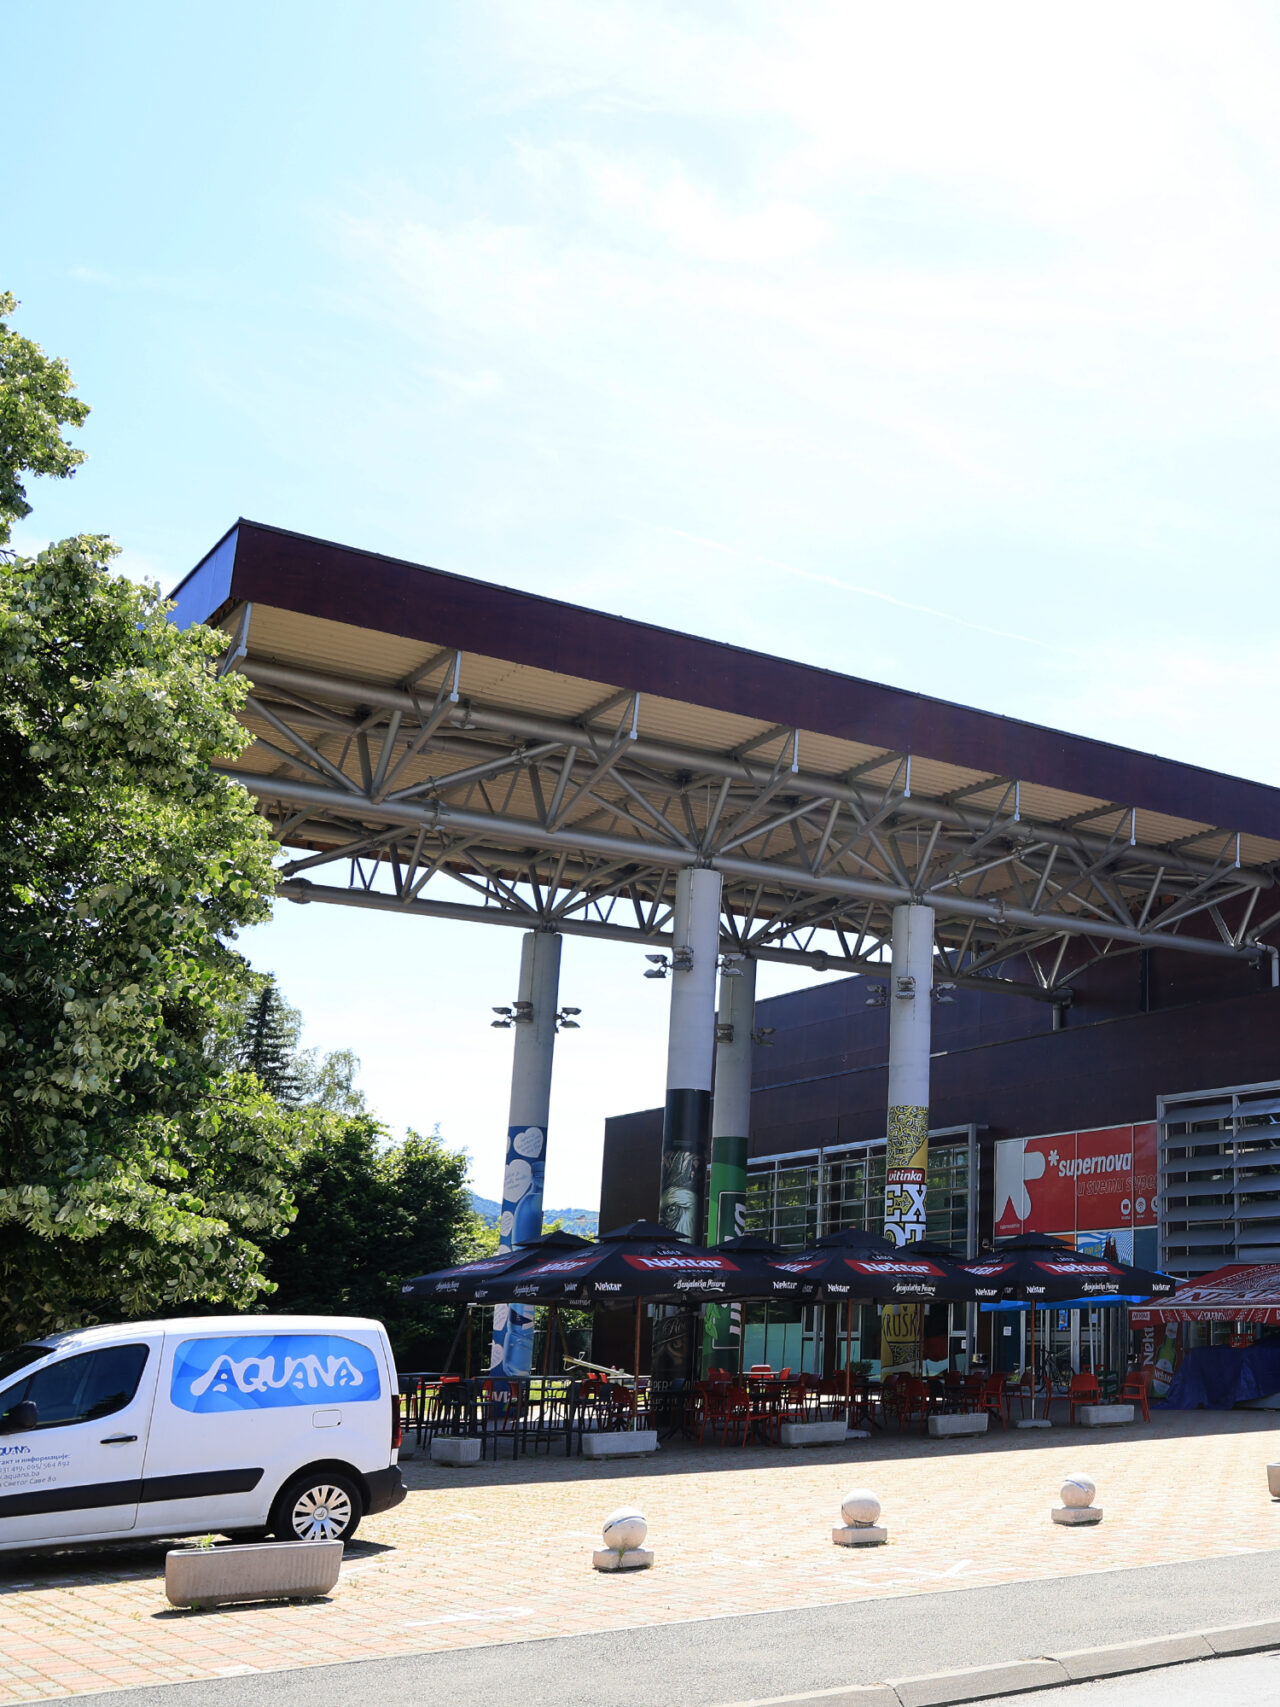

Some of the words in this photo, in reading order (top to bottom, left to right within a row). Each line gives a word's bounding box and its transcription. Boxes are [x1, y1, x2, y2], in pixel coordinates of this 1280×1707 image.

[1058, 1152, 1132, 1180] supernova
[888, 1170, 923, 1181] vitinka
[1077, 1182, 1087, 1197] u
[1088, 1178, 1125, 1195] svemu
[1125, 1174, 1158, 1194] supe
[885, 1184, 927, 1222] EX
[636, 1258, 724, 1268] Nektar
[857, 1262, 932, 1274] Nektar
[1046, 1263, 1112, 1274] Nektar
[594, 1282, 622, 1291] Nektar
[773, 1281, 797, 1290] Nektar
[827, 1283, 850, 1293] Nektar
[1026, 1285, 1046, 1294] Nektar
[1152, 1282, 1171, 1292] Nektar
[975, 1288, 997, 1297] Nektar
[1142, 1326, 1154, 1365] Nekt
[190, 1354, 364, 1396] AQUANA
[0, 1446, 31, 1456] QUANA
[0, 1471, 40, 1480] .aquana.ba
